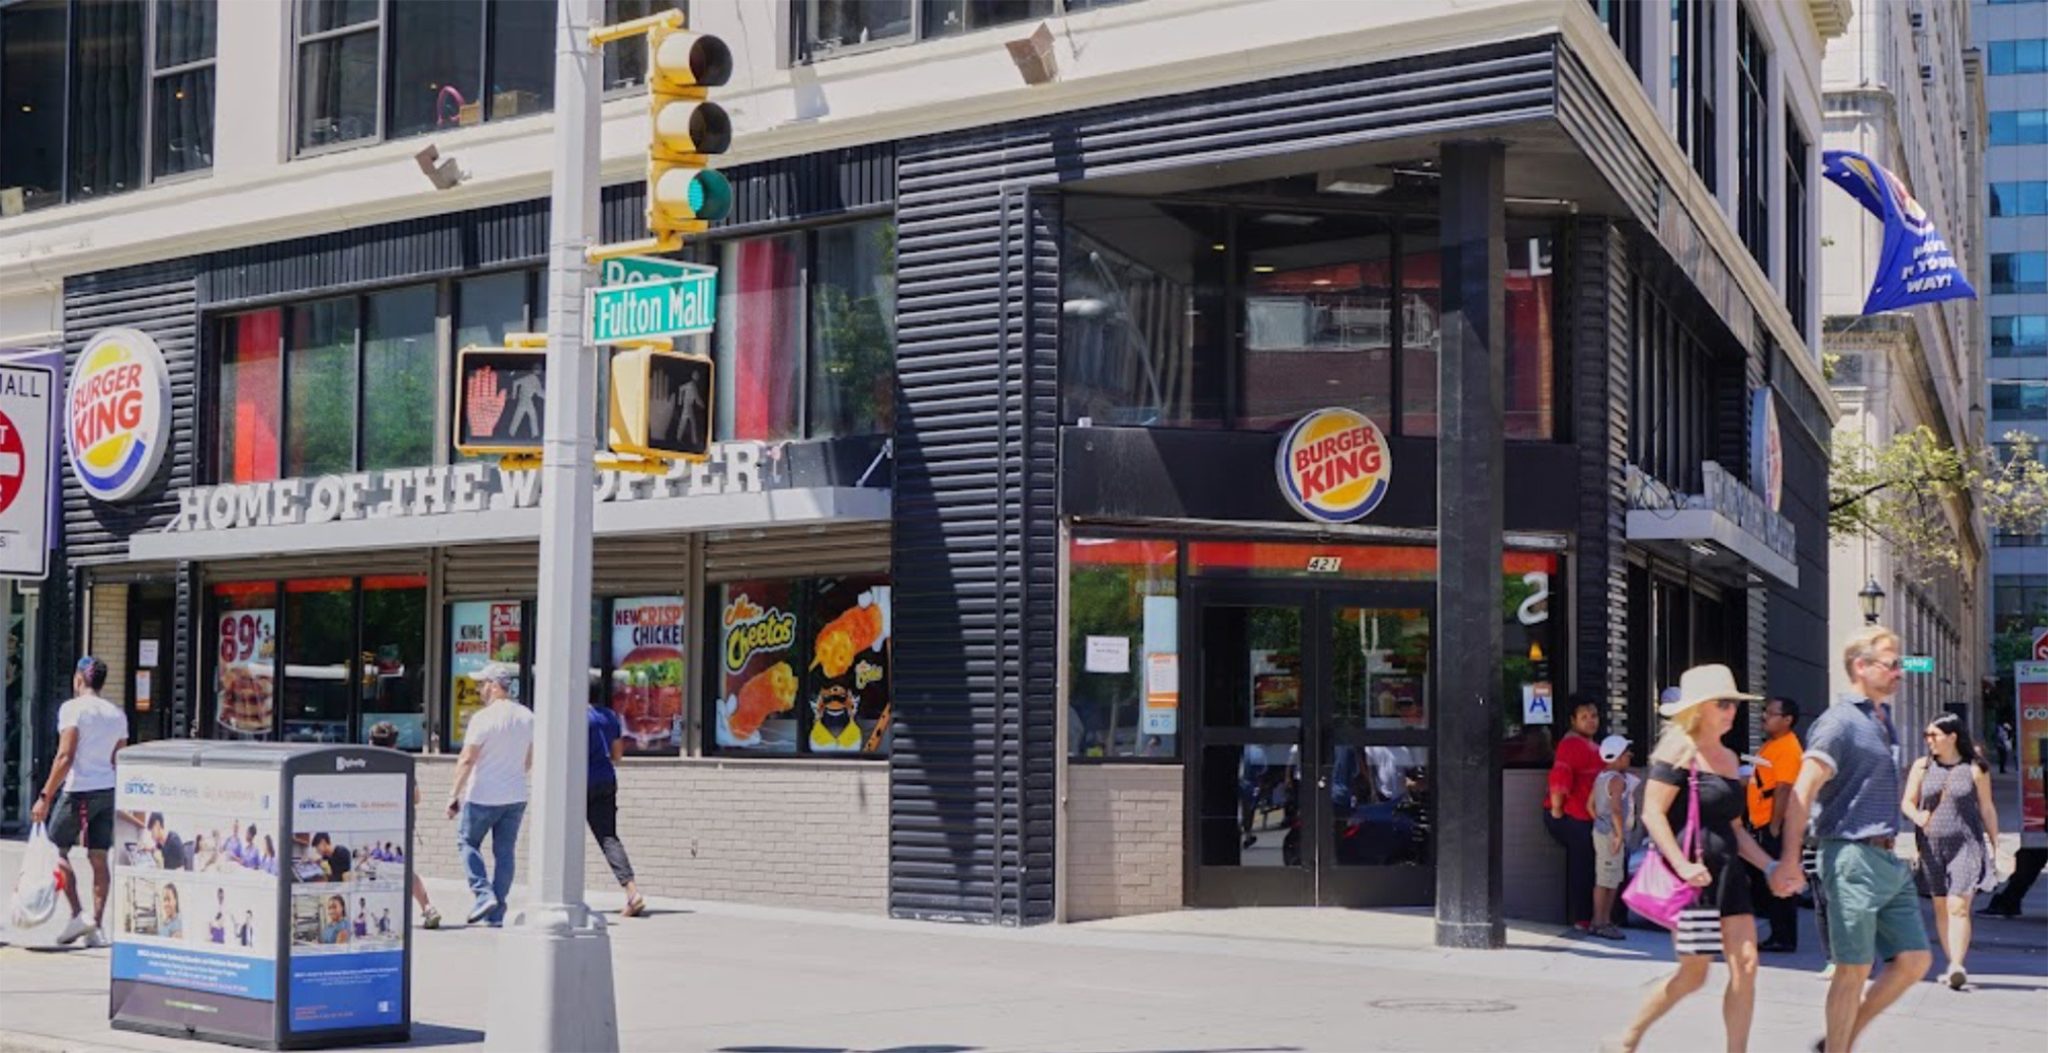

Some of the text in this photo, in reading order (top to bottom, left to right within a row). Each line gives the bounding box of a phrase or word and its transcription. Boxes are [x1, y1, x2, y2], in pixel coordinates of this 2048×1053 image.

[599, 279, 710, 338] Fulton Mall
[0, 374, 41, 398] ALL
[75, 363, 142, 415] BURGER
[75, 390, 143, 457] KING
[1295, 426, 1375, 471] BURGER
[178, 442, 763, 532] HOME OF THE WOPPER
[1301, 445, 1381, 501] KING
[1309, 559, 1337, 570] 421
[615, 605, 684, 626] NEW CRISP
[728, 613, 793, 671] Cheetos
[1529, 697, 1548, 713] A
